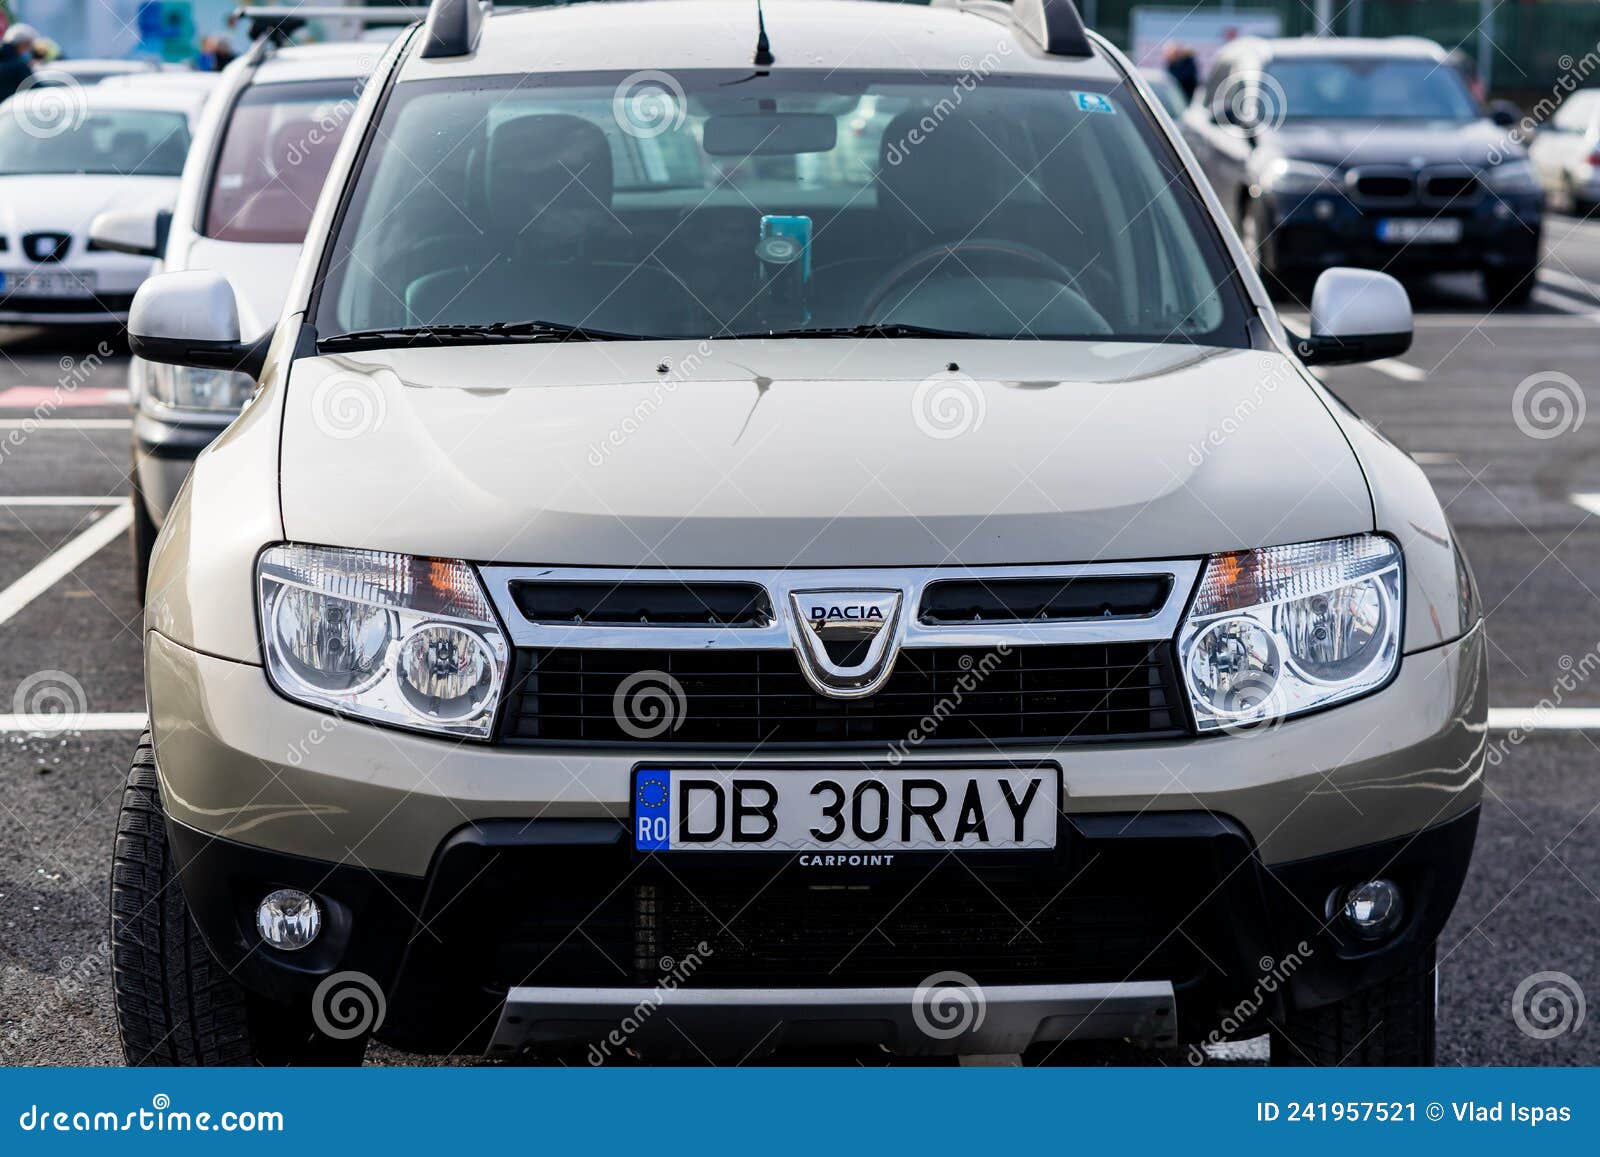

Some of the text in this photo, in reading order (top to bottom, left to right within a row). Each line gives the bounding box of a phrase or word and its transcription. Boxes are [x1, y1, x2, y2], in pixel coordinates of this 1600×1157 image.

[811, 606, 883, 619] DACIA
[679, 779, 779, 843] DB
[638, 816, 667, 841] RO
[799, 854, 894, 866] CARPOINT
